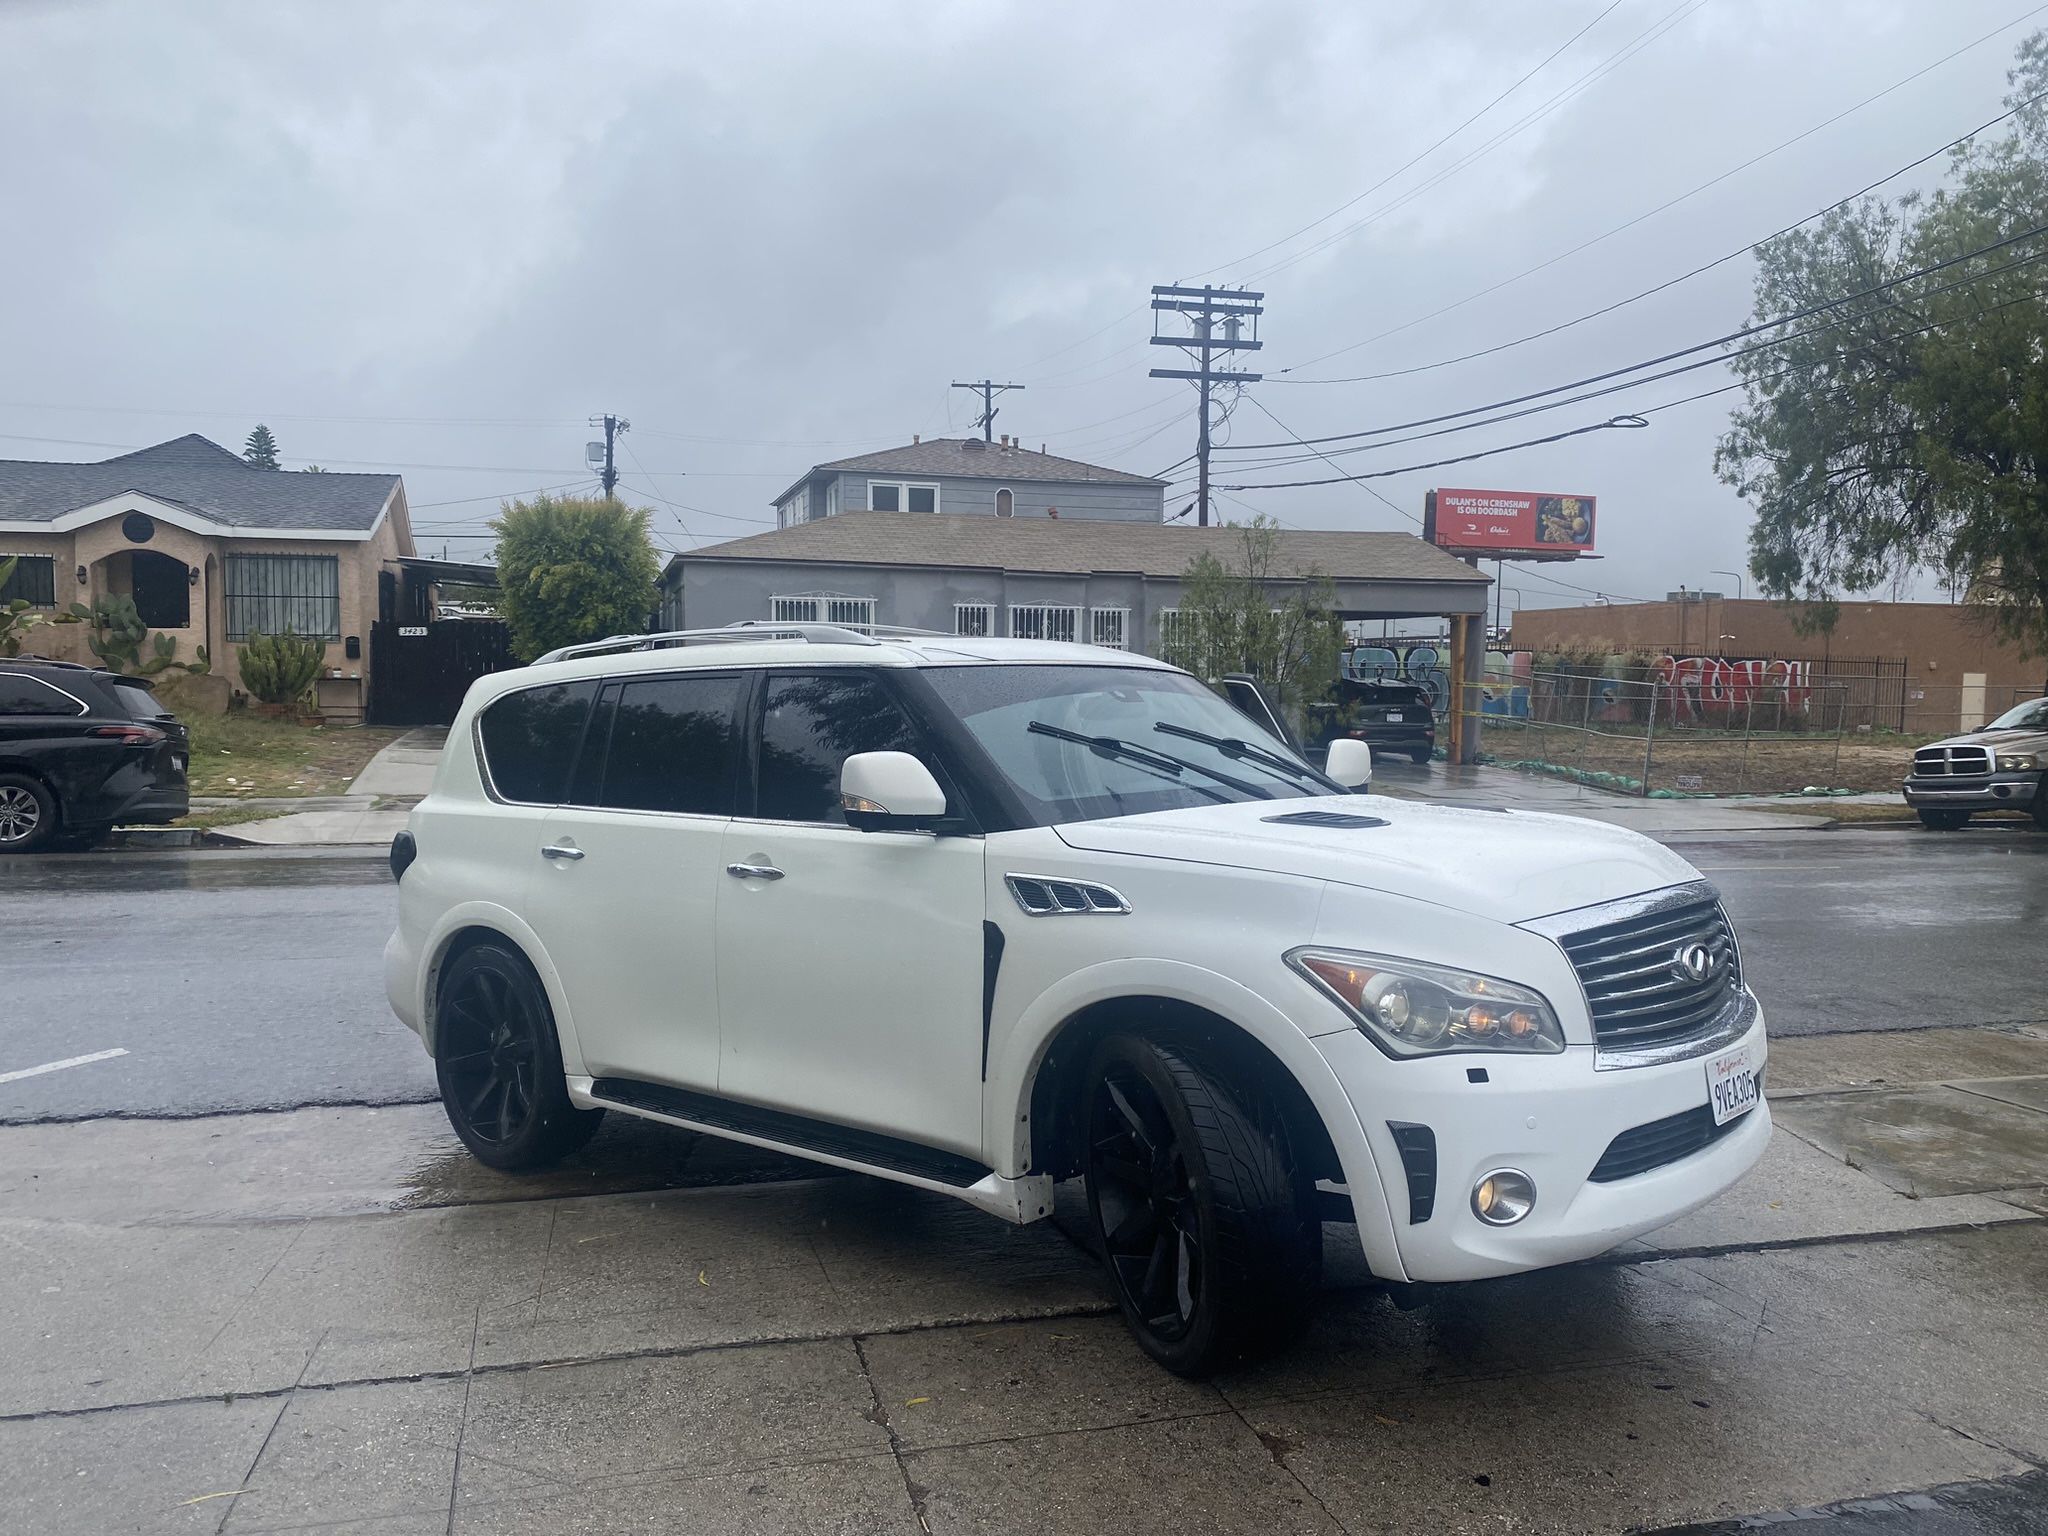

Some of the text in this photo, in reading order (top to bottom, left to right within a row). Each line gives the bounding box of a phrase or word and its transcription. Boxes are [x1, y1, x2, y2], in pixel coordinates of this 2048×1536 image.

[1446, 497, 1530, 509] DULAN'S ON CRENSHAW
[1457, 506, 1465, 514] IS
[1477, 507, 1518, 517] DOORDASH
[402, 627, 424, 635] 3423
[1714, 1069, 1755, 1115] 9VEA305
